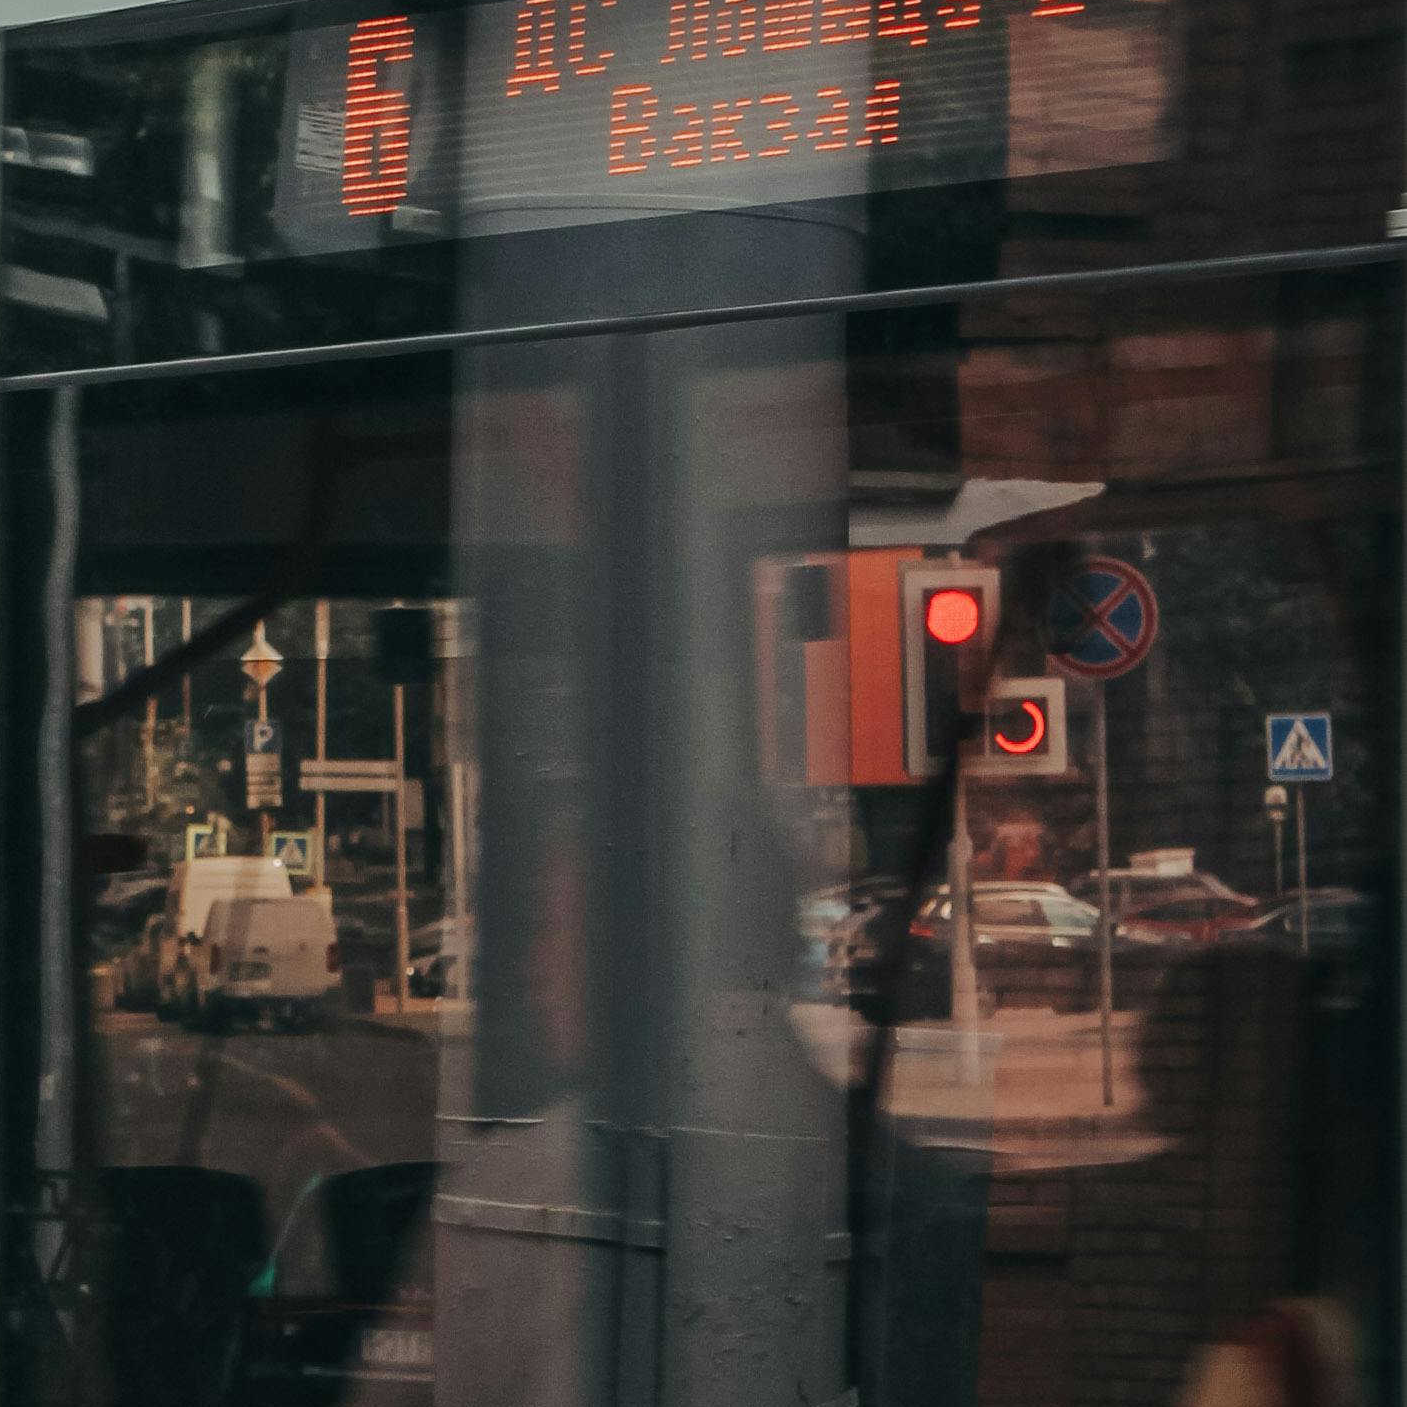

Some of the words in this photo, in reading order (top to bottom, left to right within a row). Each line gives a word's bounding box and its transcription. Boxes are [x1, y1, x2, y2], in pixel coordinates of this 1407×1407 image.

[342, 14, 415, 216] 6
[607, 79, 901, 175] Вакзал
[253, 721, 274, 753] P
